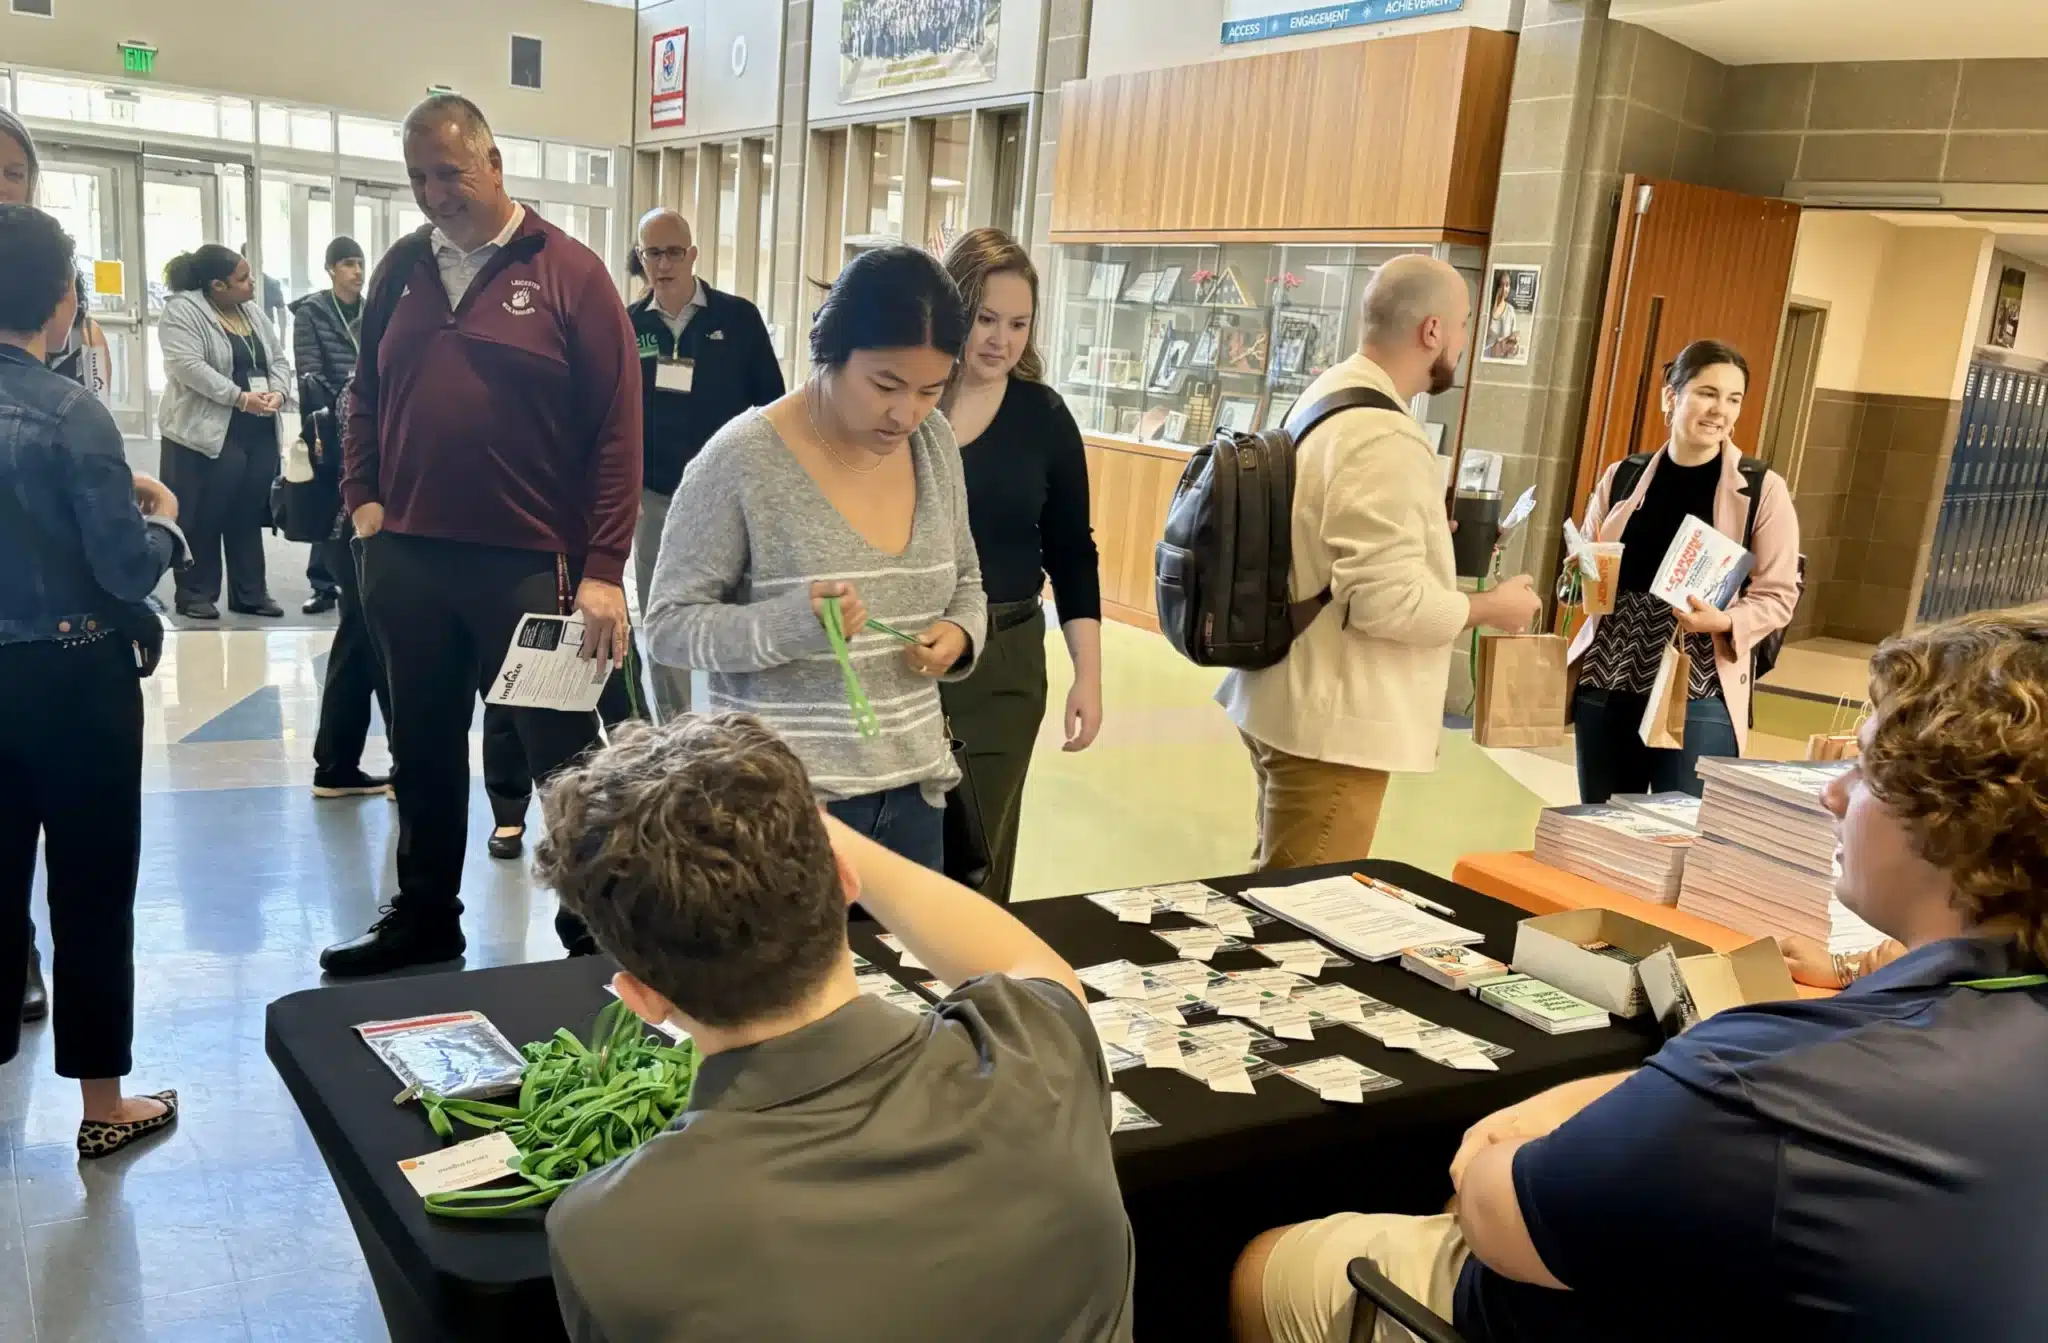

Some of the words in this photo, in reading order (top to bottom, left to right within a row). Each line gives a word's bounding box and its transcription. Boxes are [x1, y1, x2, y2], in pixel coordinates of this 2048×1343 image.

[1229, 23, 1260, 38] ACCESS
[1290, 8, 1350, 29] ENGAGEMENT
[125, 48, 153, 72] EXIT
[511, 279, 541, 291] LEICESTER
[499, 663, 523, 700] ImBlaze
